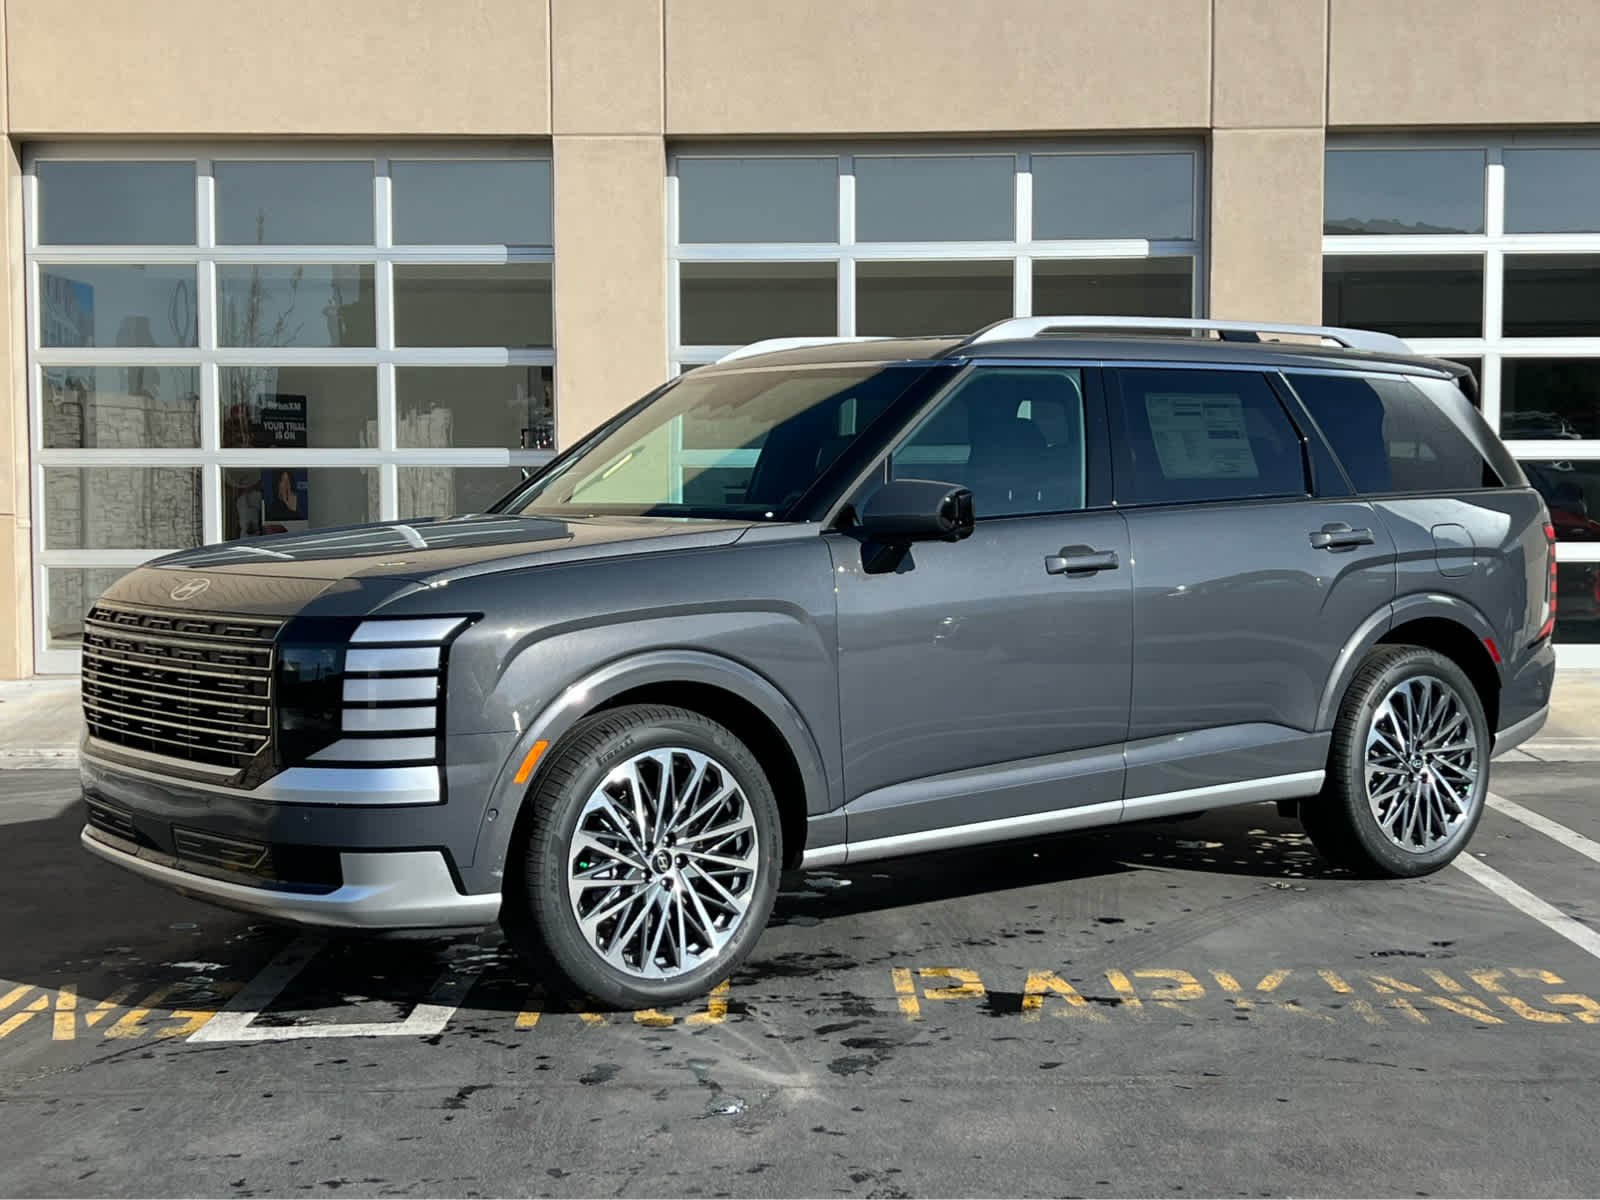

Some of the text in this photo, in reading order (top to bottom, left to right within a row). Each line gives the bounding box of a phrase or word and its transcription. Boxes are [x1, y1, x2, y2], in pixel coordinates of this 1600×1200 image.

[263, 422, 284, 431] YOUR
[284, 431, 296, 440] ON
[891, 967, 1600, 1024] PARKING
